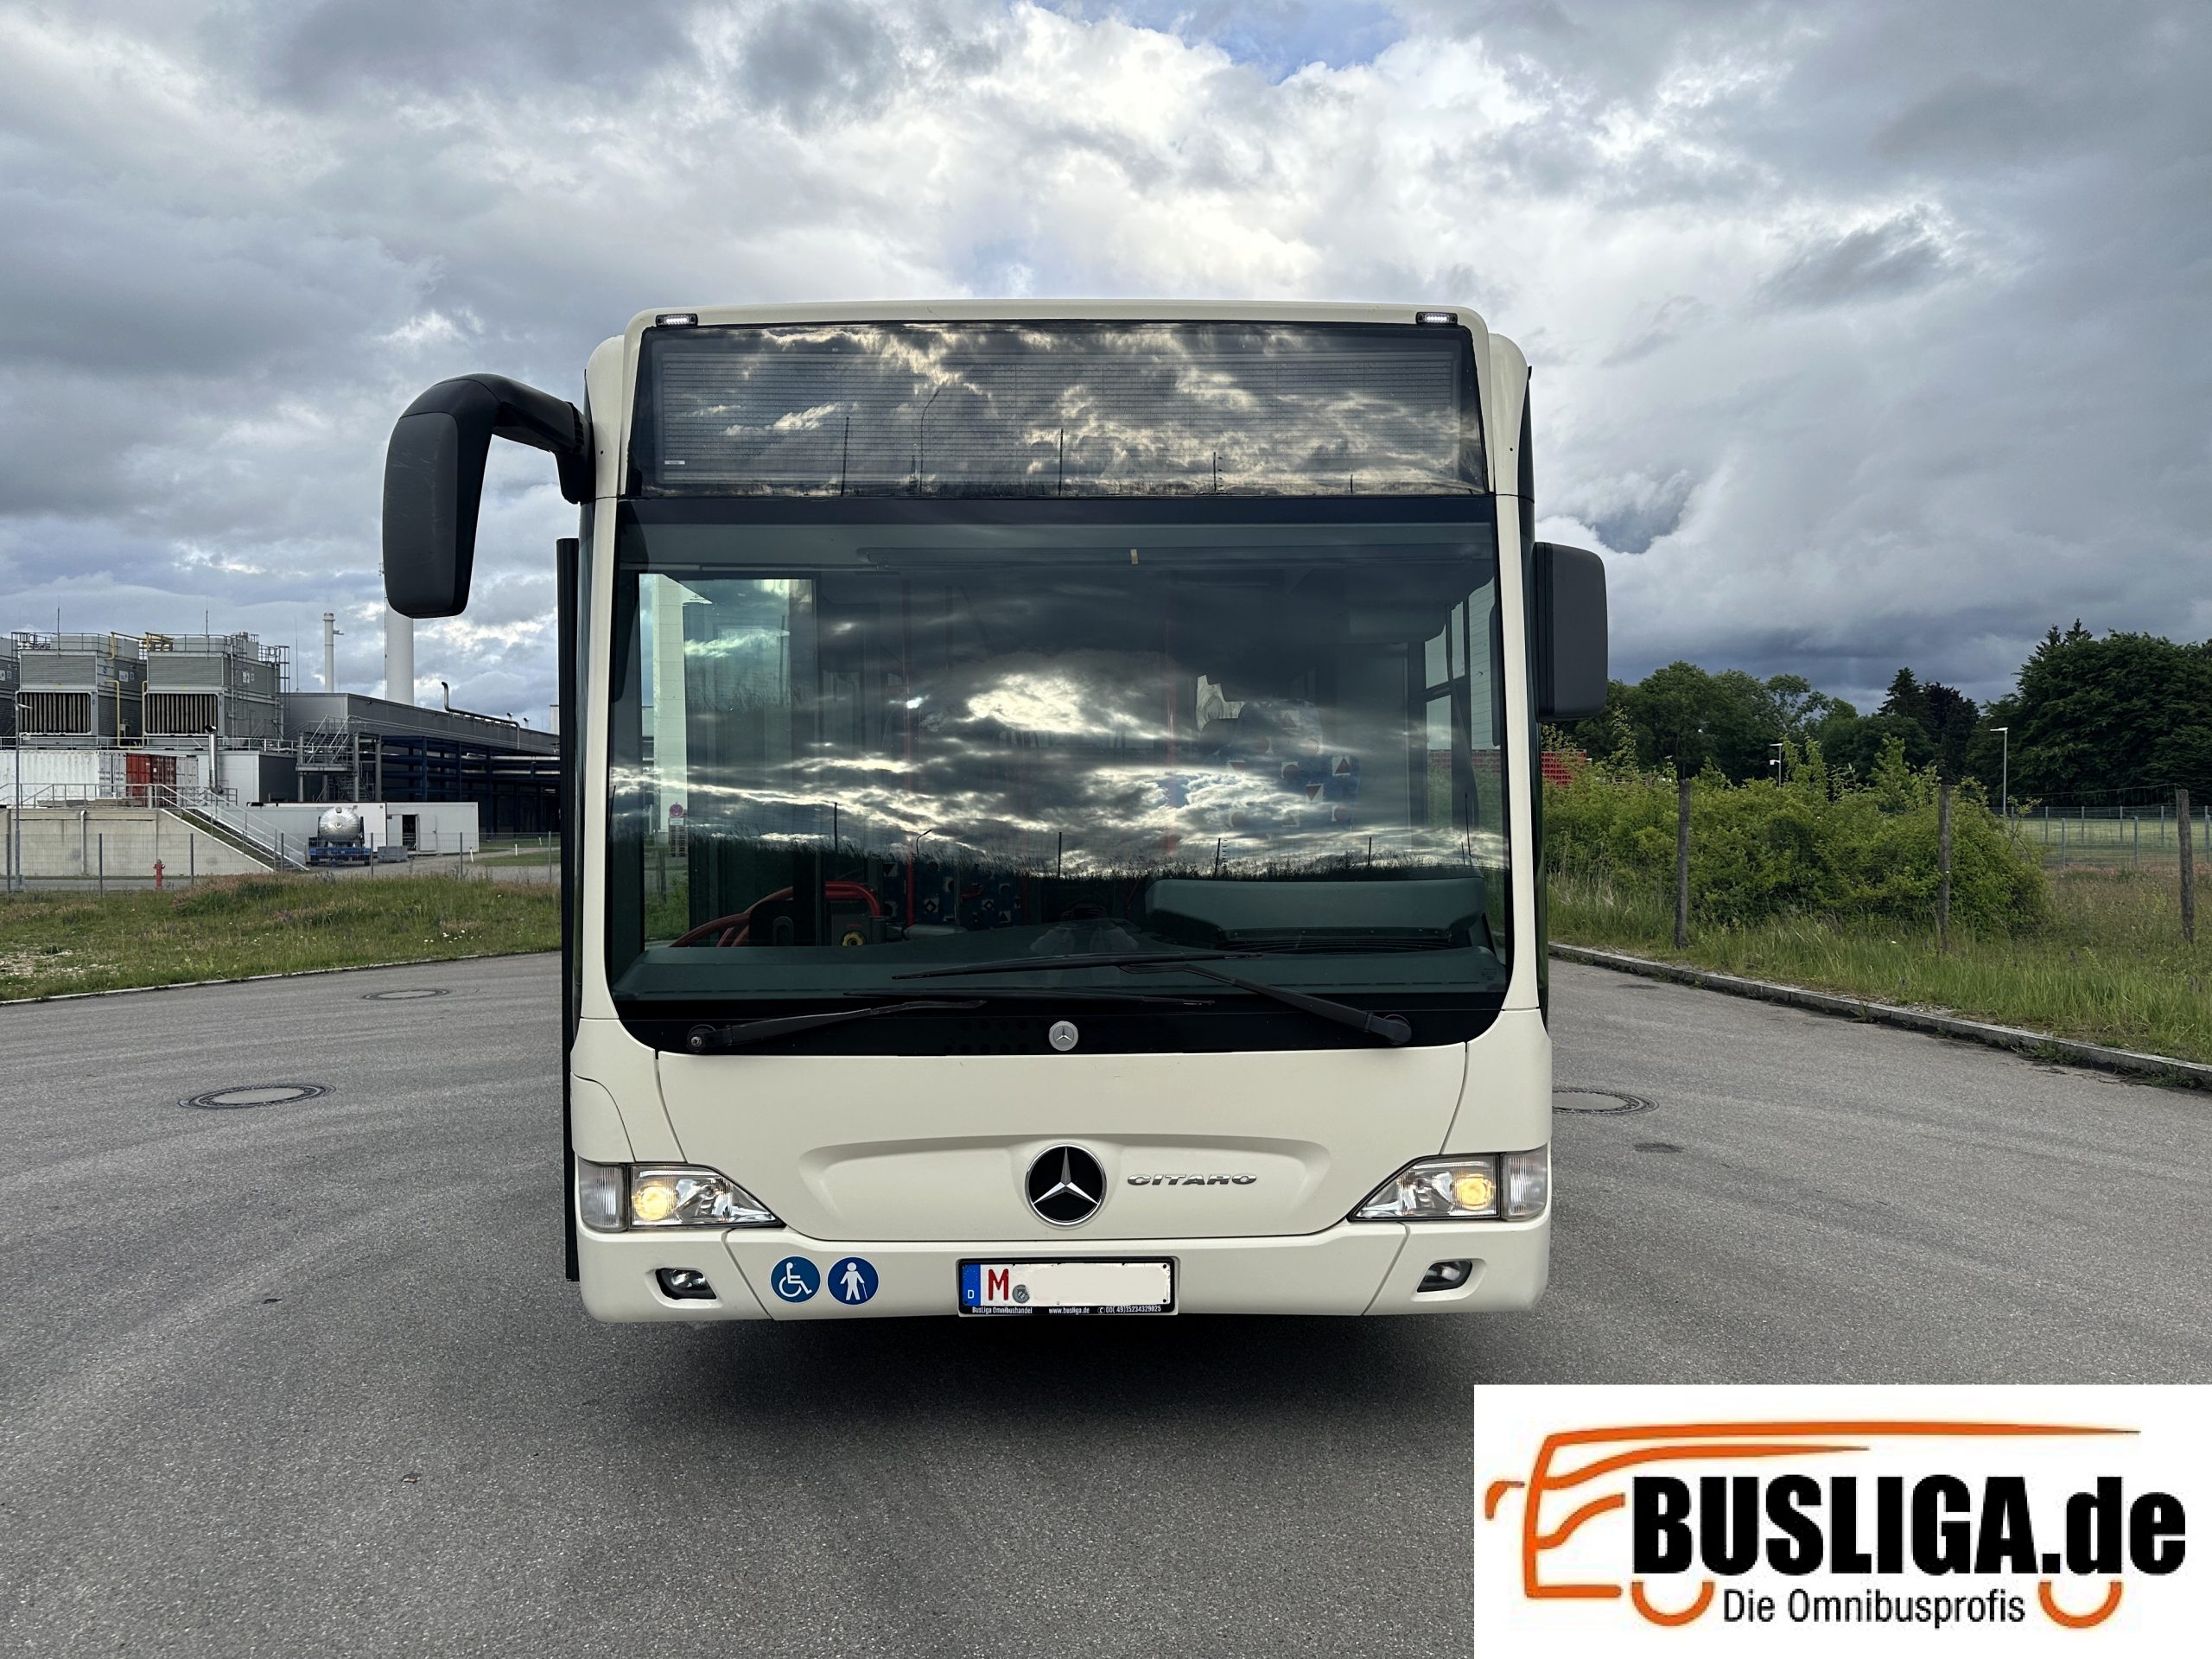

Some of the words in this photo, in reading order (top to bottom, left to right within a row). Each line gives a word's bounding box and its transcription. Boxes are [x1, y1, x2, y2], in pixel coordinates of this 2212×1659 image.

[1127, 1173, 1257, 1185] CITARO
[988, 1268, 1009, 1300] M
[967, 1289, 975, 1299] D
[1048, 1306, 1090, 1315] www.busliga.de
